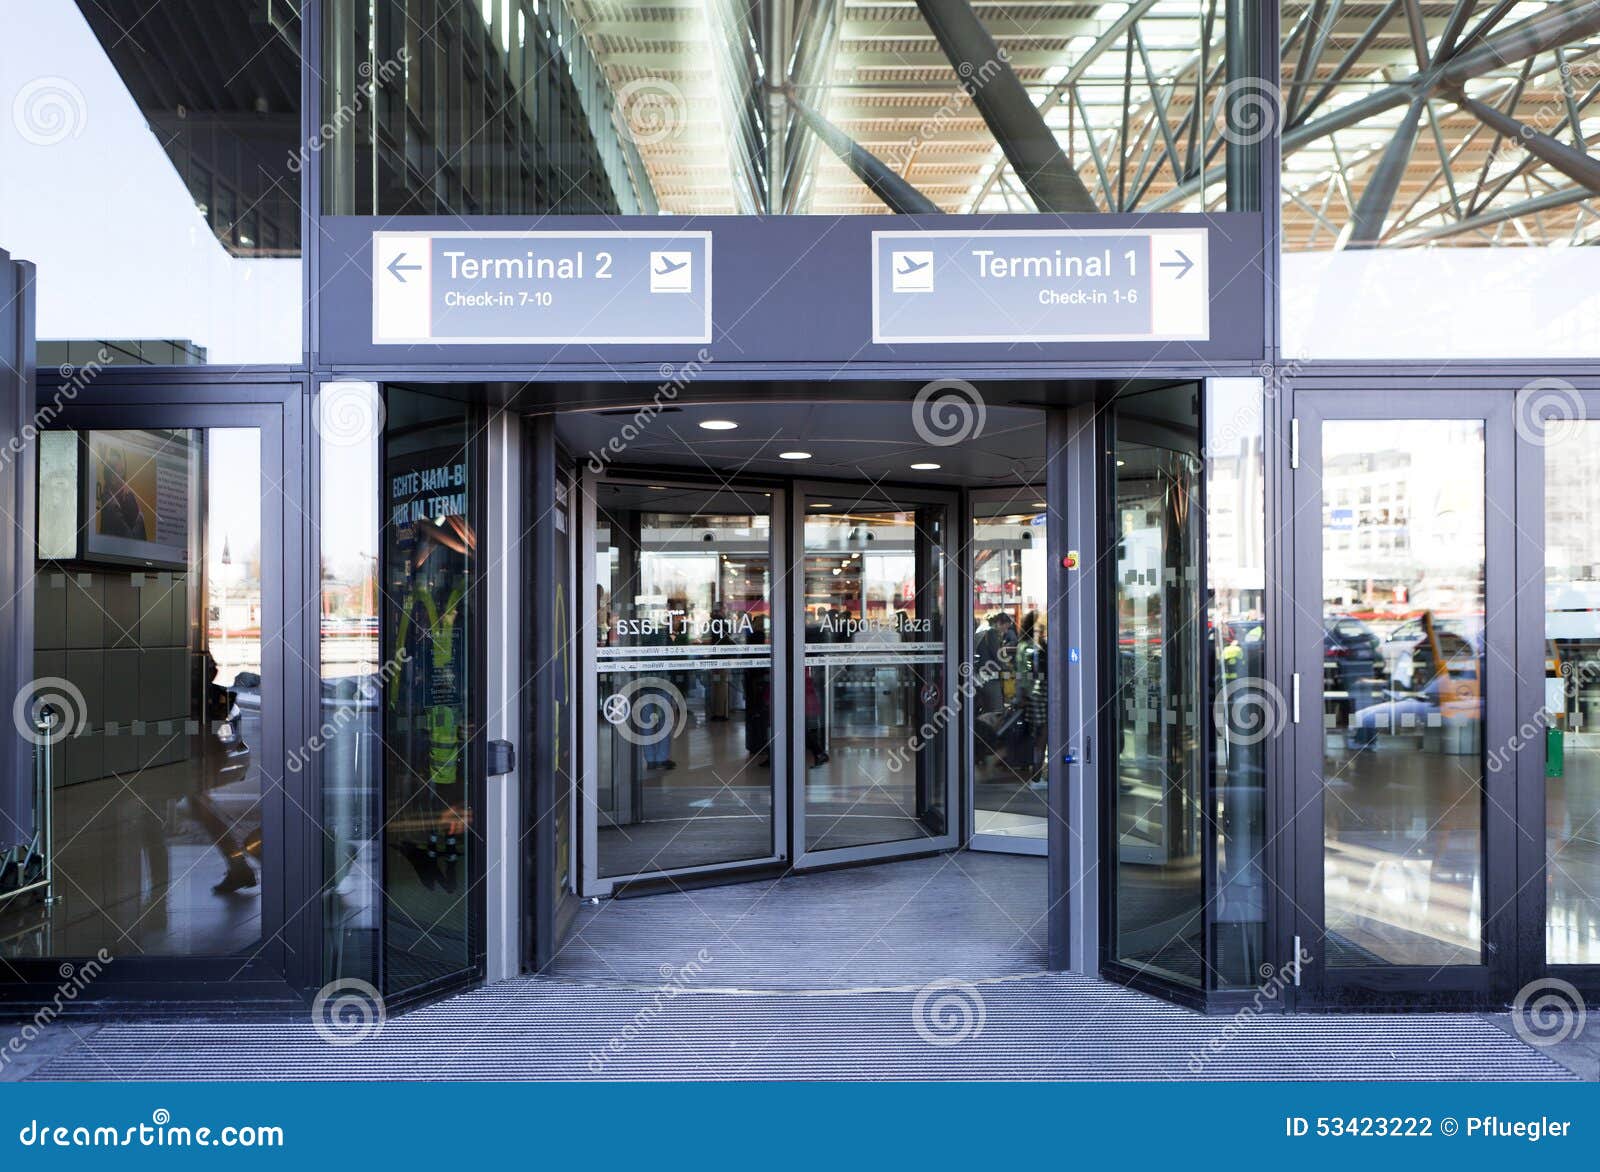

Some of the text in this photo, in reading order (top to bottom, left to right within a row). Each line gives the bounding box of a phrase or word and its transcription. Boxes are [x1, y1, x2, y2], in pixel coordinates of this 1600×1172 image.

[444, 251, 613, 279] Terminal 2
[972, 249, 1136, 278] Terminal 1
[445, 291, 552, 306] Check-in 7-10
[1038, 289, 1137, 304] Check-in 1-6
[393, 472, 419, 498] ECHTE
[392, 503, 409, 526] NUR
[411, 499, 425, 521] IM
[819, 613, 932, 638] Airport Plaza
